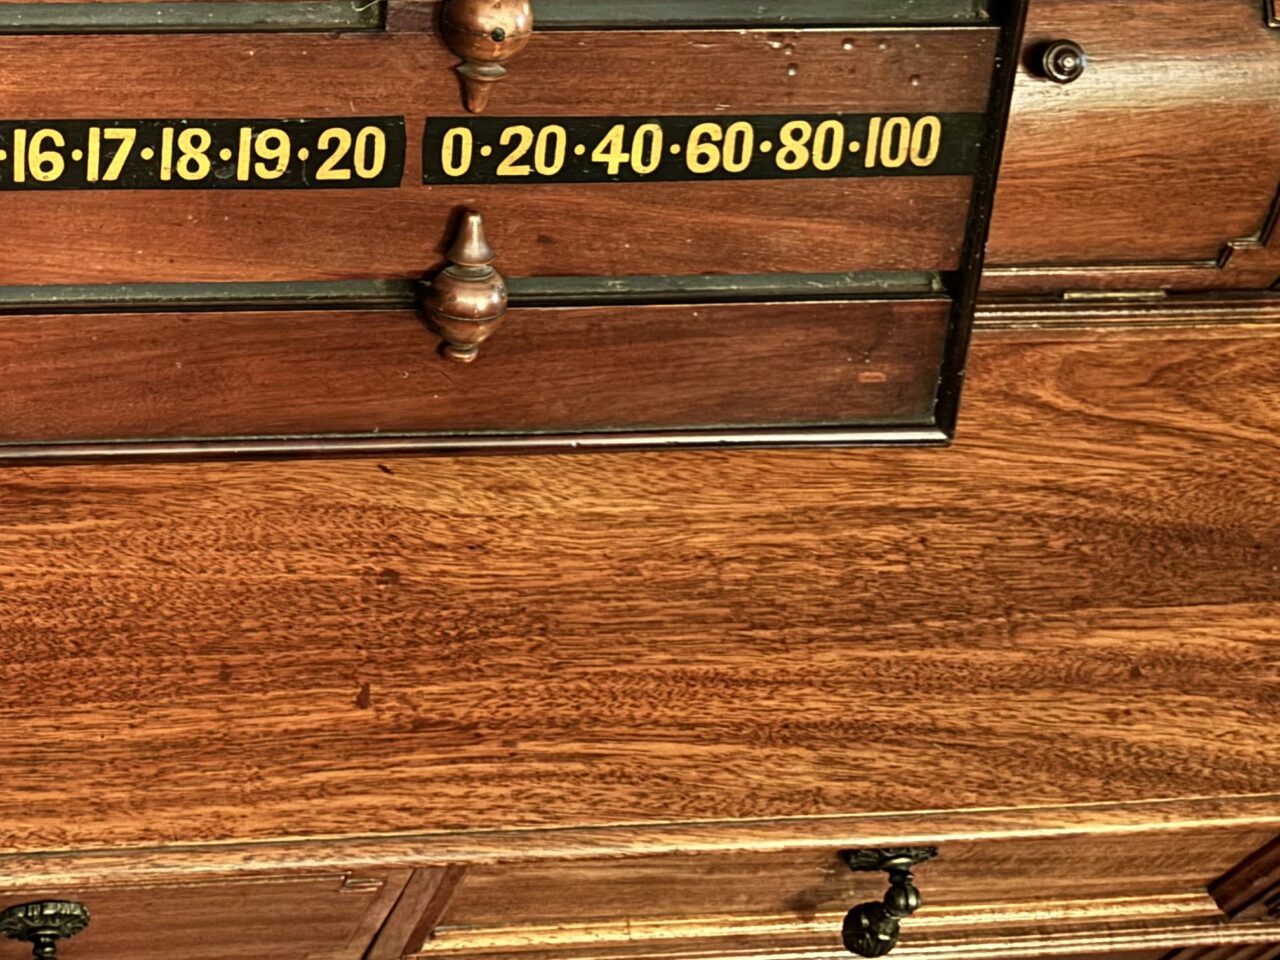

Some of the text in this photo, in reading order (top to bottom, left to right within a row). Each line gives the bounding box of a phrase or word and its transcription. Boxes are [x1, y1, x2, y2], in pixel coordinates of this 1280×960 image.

[12, 128, 65, 183] 16
[85, 127, 138, 182] 17
[160, 127, 213, 182] 18
[235, 127, 291, 181] 19
[314, 126, 387, 181] 20
[441, 115, 942, 178] 0 20 40 60 80 100
